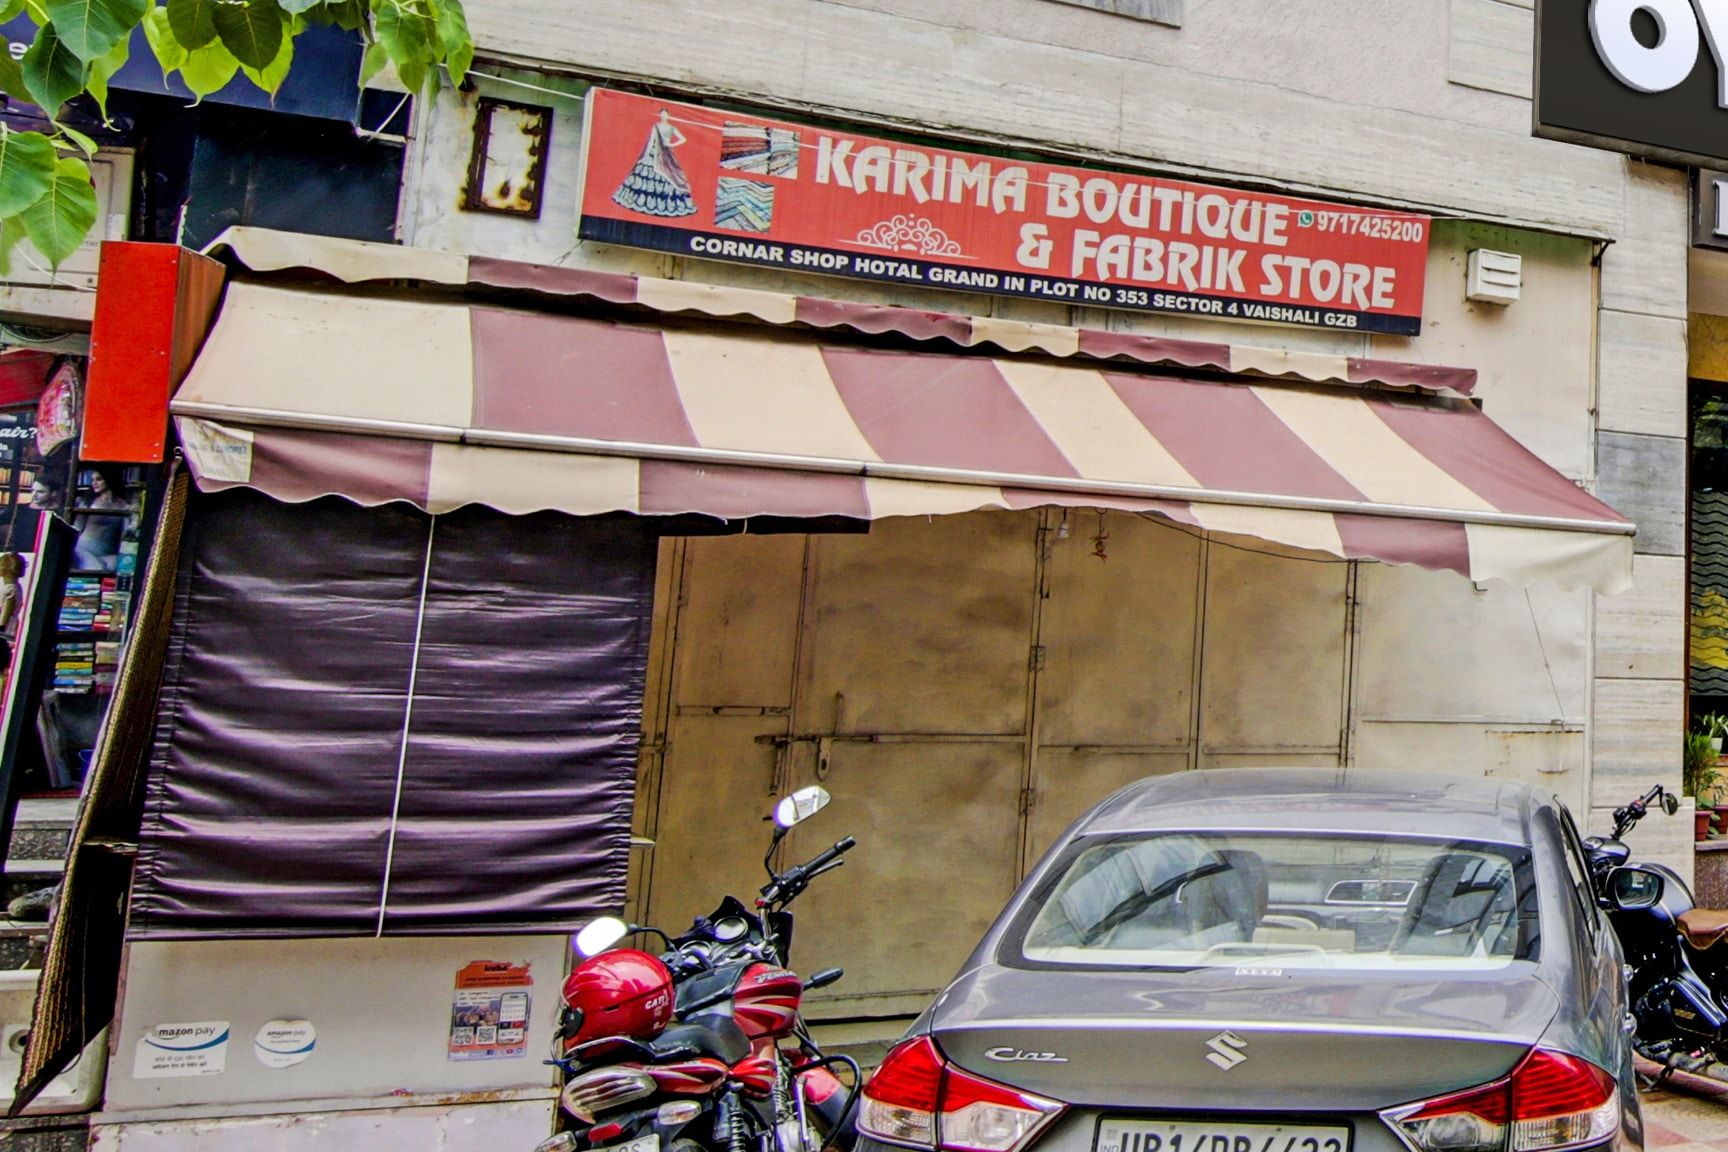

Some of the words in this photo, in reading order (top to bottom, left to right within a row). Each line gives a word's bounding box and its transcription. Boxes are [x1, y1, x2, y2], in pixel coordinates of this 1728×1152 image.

[815, 135, 1028, 214] KARIMA
[1046, 171, 1290, 246] BOUTIQUE
[1317, 212, 1424, 243] 9717425200
[690, 235, 784, 262] CORNAR
[790, 249, 849, 270] SHOP
[854, 257, 922, 280] HOTAL
[928, 267, 998, 289] GRAND
[1004, 275, 1024, 292] IN
[1030, 279, 1079, 297] PLOT
[1084, 284, 1111, 301] NO
[1116, 289, 1148, 306] 353
[1153, 293, 1223, 315] SECTOR
[1227, 302, 1238, 315] 4
[1243, 304, 1320, 325] VAISHALI
[1324, 312, 1358, 328] GZB
[1017, 223, 1053, 269] &
[1071, 229, 1248, 292] FABRIK
[1260, 253, 1396, 311] STORE
[153, 1027, 194, 1036] mazon
[984, 1047, 1068, 1061] Ciaz
